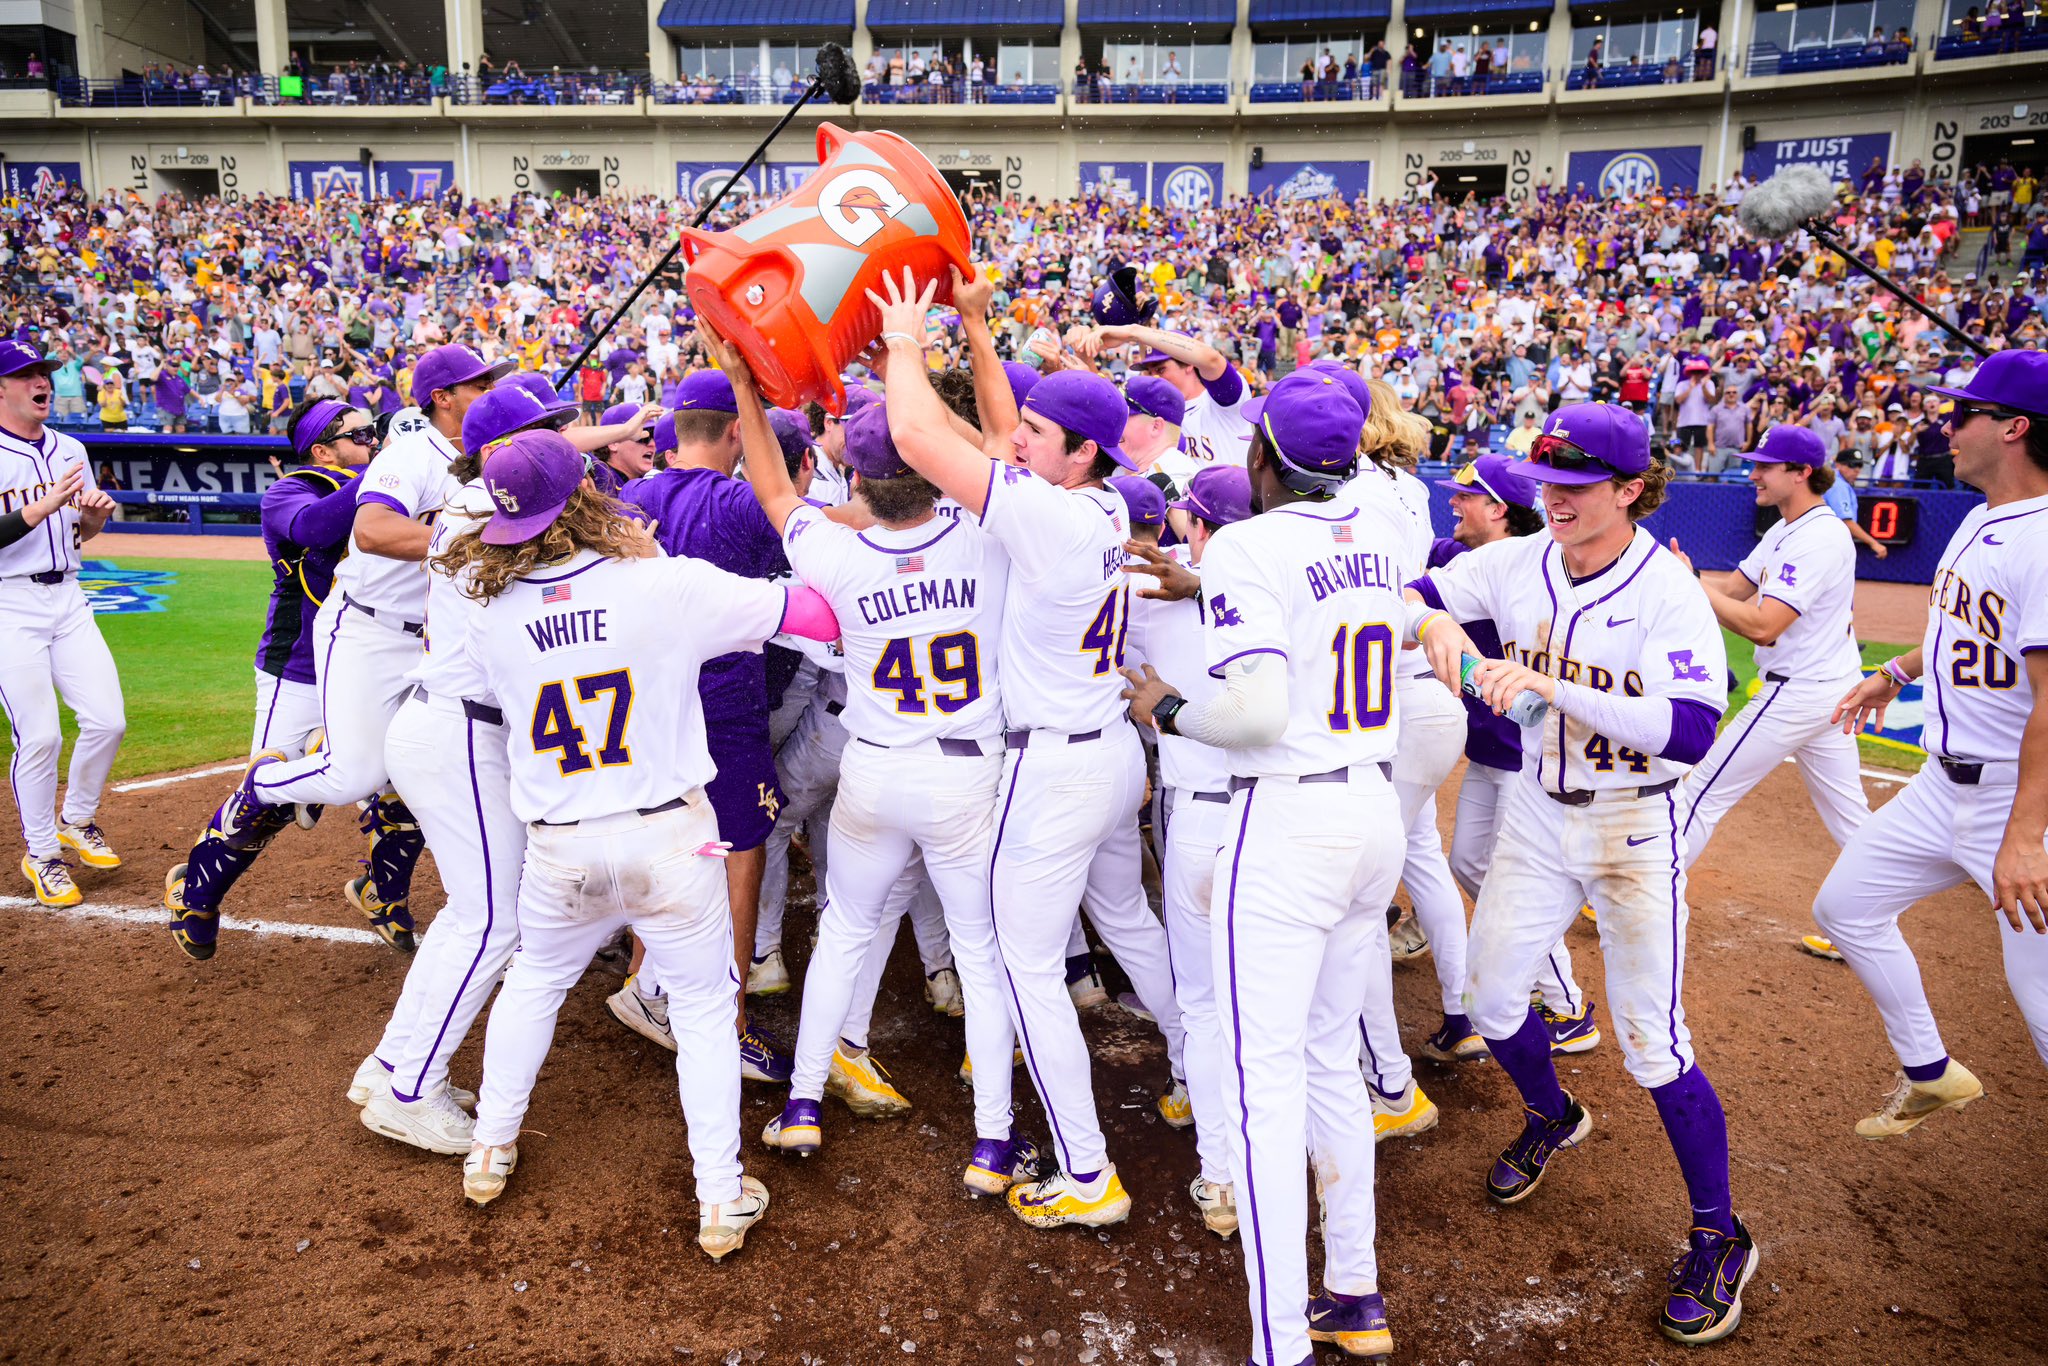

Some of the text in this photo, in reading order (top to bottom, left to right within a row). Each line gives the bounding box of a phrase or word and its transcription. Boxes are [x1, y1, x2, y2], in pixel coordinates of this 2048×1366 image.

[1980, 115, 2010, 129] 203
[161, 154, 178, 164] 211
[190, 154, 209, 164] 209
[543, 154, 563, 165] 209
[570, 154, 590, 165] 207
[938, 155, 959, 165] 207
[971, 155, 992, 165] 205
[1440, 151, 1462, 161] 205
[1474, 149, 1497, 160] 203
[1776, 137, 1853, 159] IT JUST
[1933, 121, 1958, 179] 203
[131, 155, 148, 189] 211
[1511, 149, 1531, 203] 203
[1774, 159, 1849, 178] MNS
[817, 169, 911, 247] G
[489, 479, 520, 513] LSU
[1870, 502, 1899, 538] 0
[857, 578, 976, 625] COLEMAN
[525, 608, 607, 653] WHITE
[871, 629, 983, 716] 49
[1327, 621, 1395, 734] 10
[1951, 639, 2018, 691] 20
[529, 667, 635, 778] 47
[1583, 732, 1649, 775] 44
